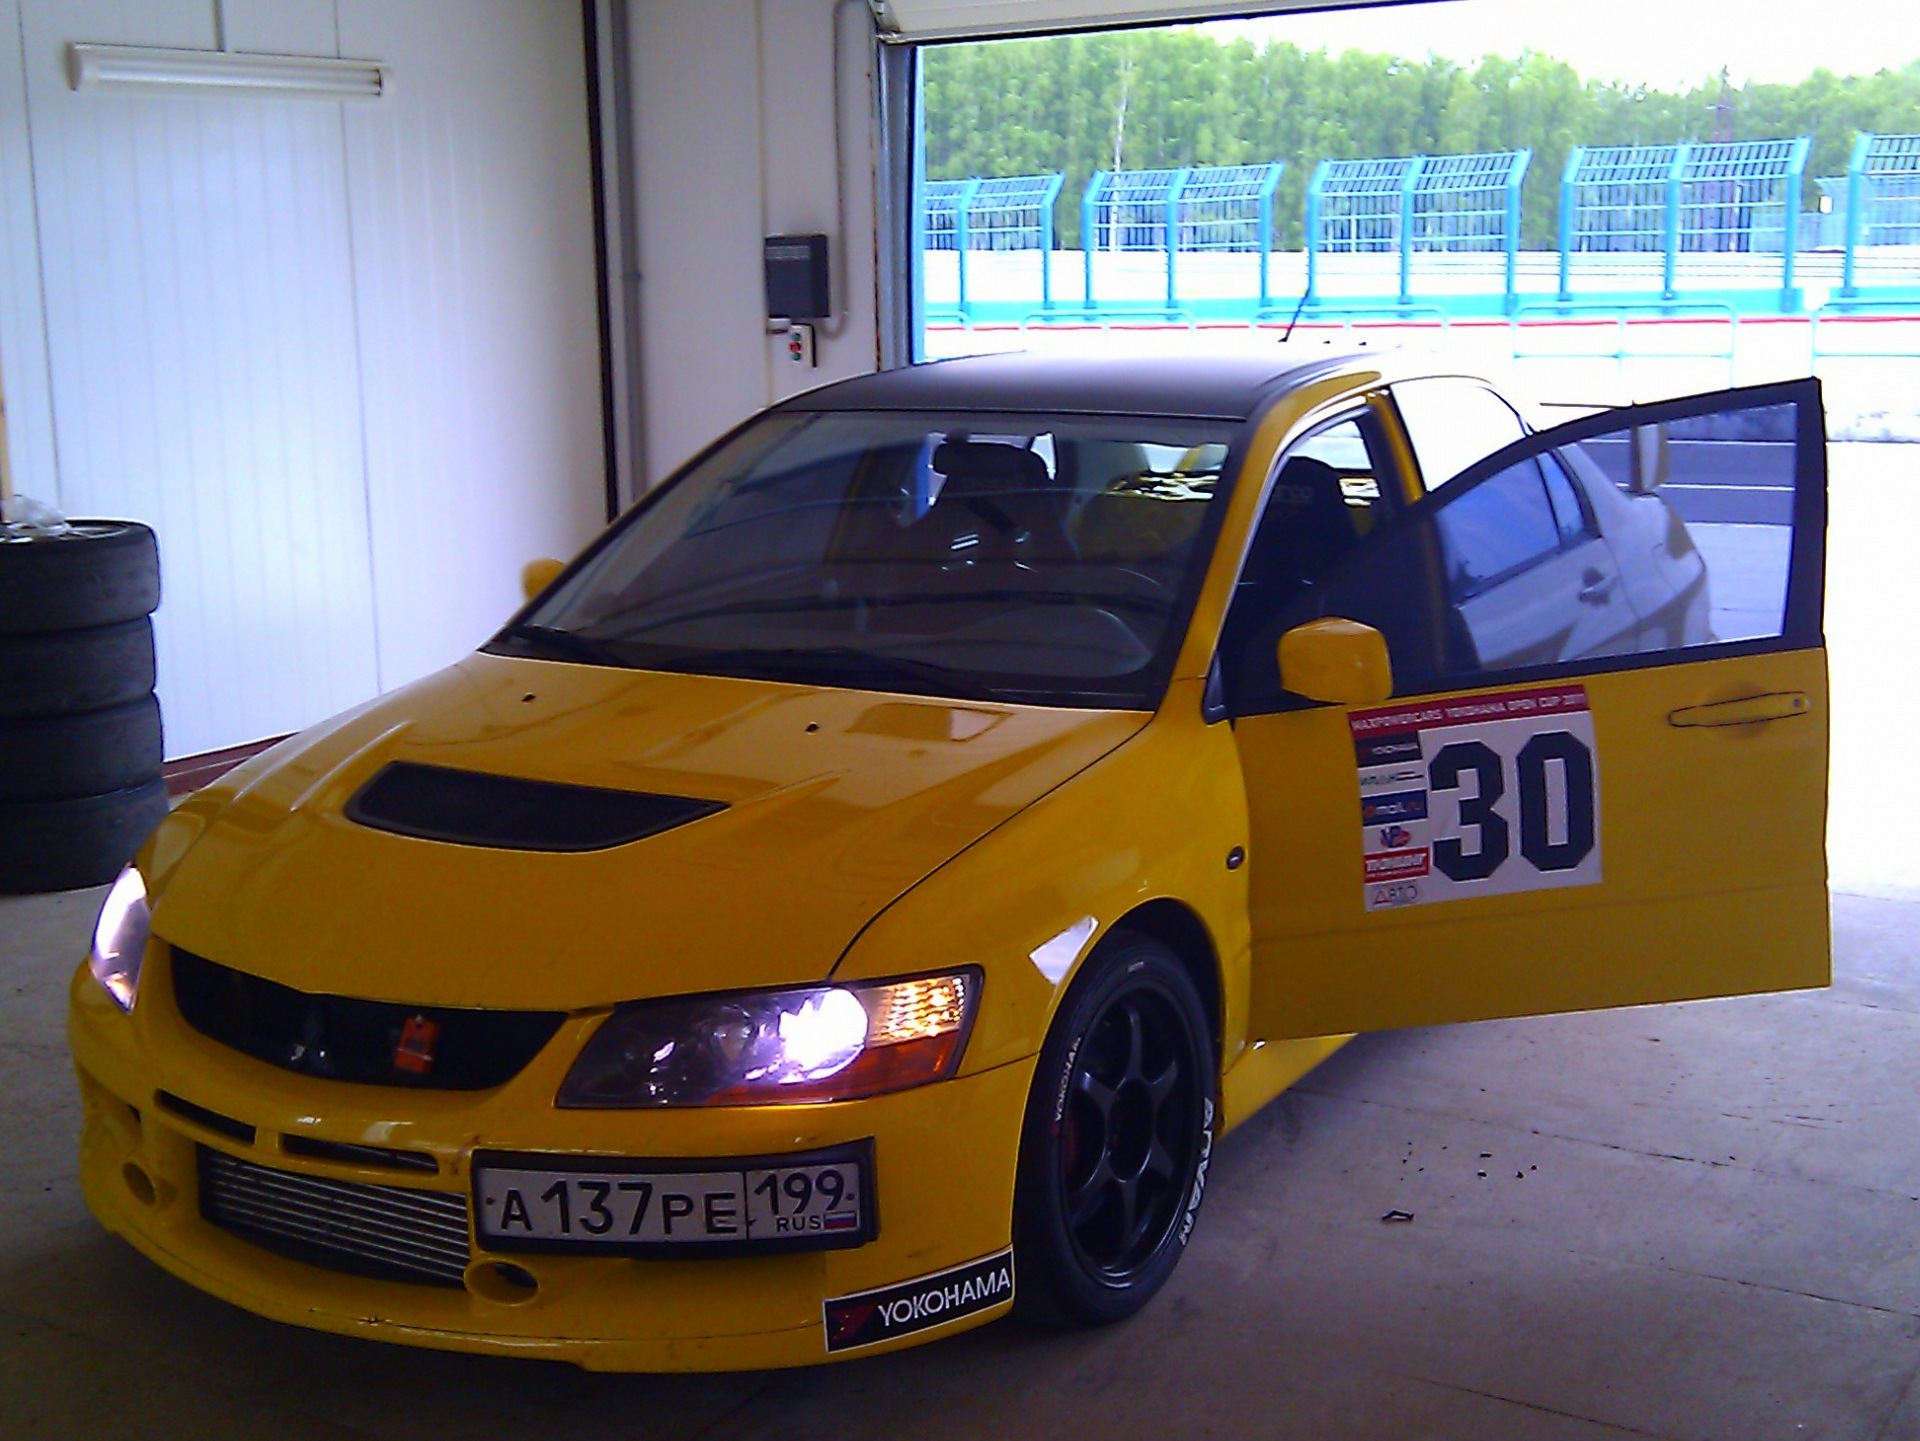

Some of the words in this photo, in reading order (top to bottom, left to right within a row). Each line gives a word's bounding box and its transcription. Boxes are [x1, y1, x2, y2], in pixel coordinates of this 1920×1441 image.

[1506, 698, 1538, 712] OPEN
[1539, 695, 1560, 709] CUP
[1429, 731, 1597, 882] 30
[1055, 1034, 1083, 1122] YOKOHAM
[753, 1168, 846, 1215] 199
[776, 1214, 822, 1233] RUS
[877, 1267, 1012, 1327] YOKOHAMA
